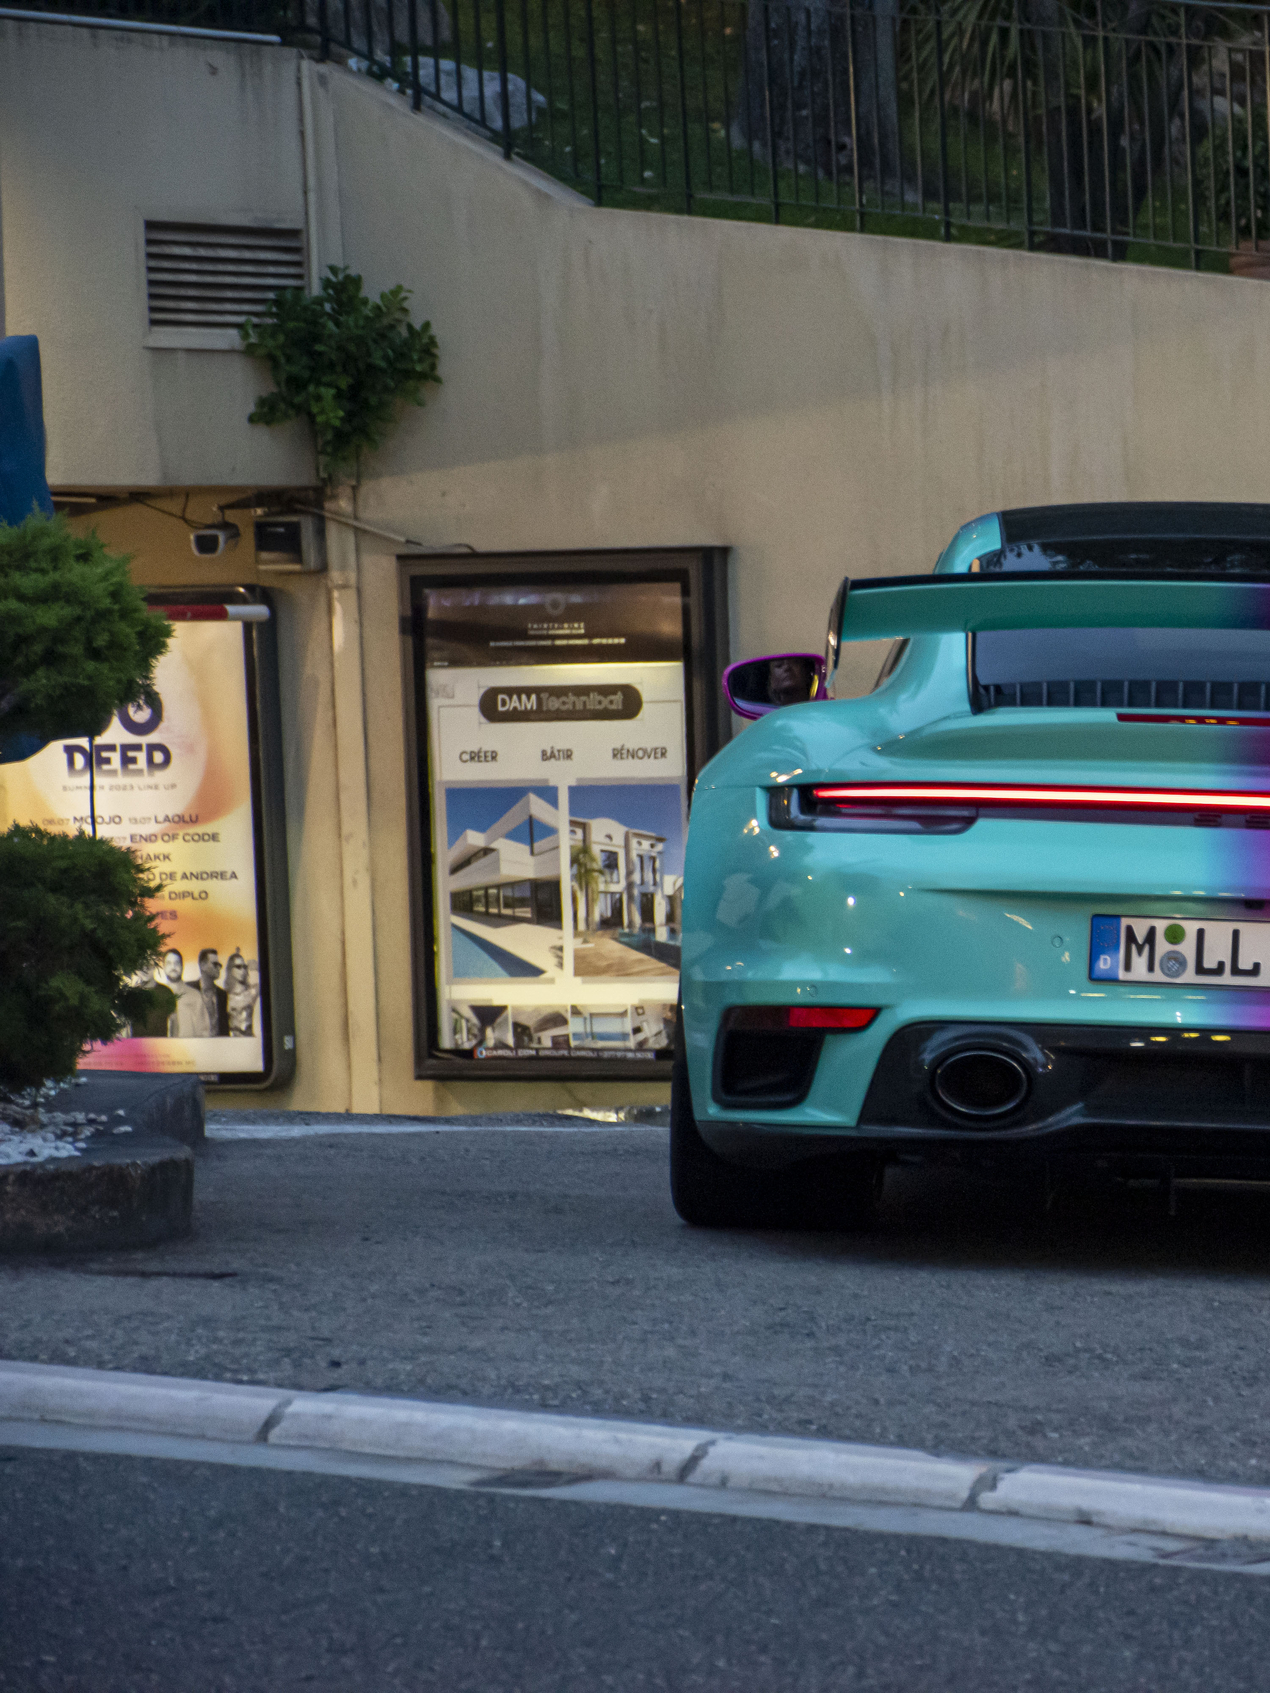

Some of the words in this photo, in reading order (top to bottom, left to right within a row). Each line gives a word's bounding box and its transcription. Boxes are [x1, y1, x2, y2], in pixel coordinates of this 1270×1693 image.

[497, 693, 537, 712] DAM
[540, 690, 624, 711] Technibat
[63, 743, 172, 779] DEEP
[458, 746, 499, 764] CRÉER
[541, 745, 573, 762] BÂTIR
[611, 744, 668, 761] RÉNOVER
[154, 813, 199, 825] LAOLU
[129, 833, 158, 843] END
[160, 832, 180, 843] OF
[182, 832, 221, 843] CODE
[159, 871, 178, 881] DE
[180, 870, 239, 882] ANDREA
[168, 889, 209, 901] DIPLO
[1123, 924, 1157, 973] M
[1194, 927, 1261, 977] LL
[1099, 955, 1111, 970] D
